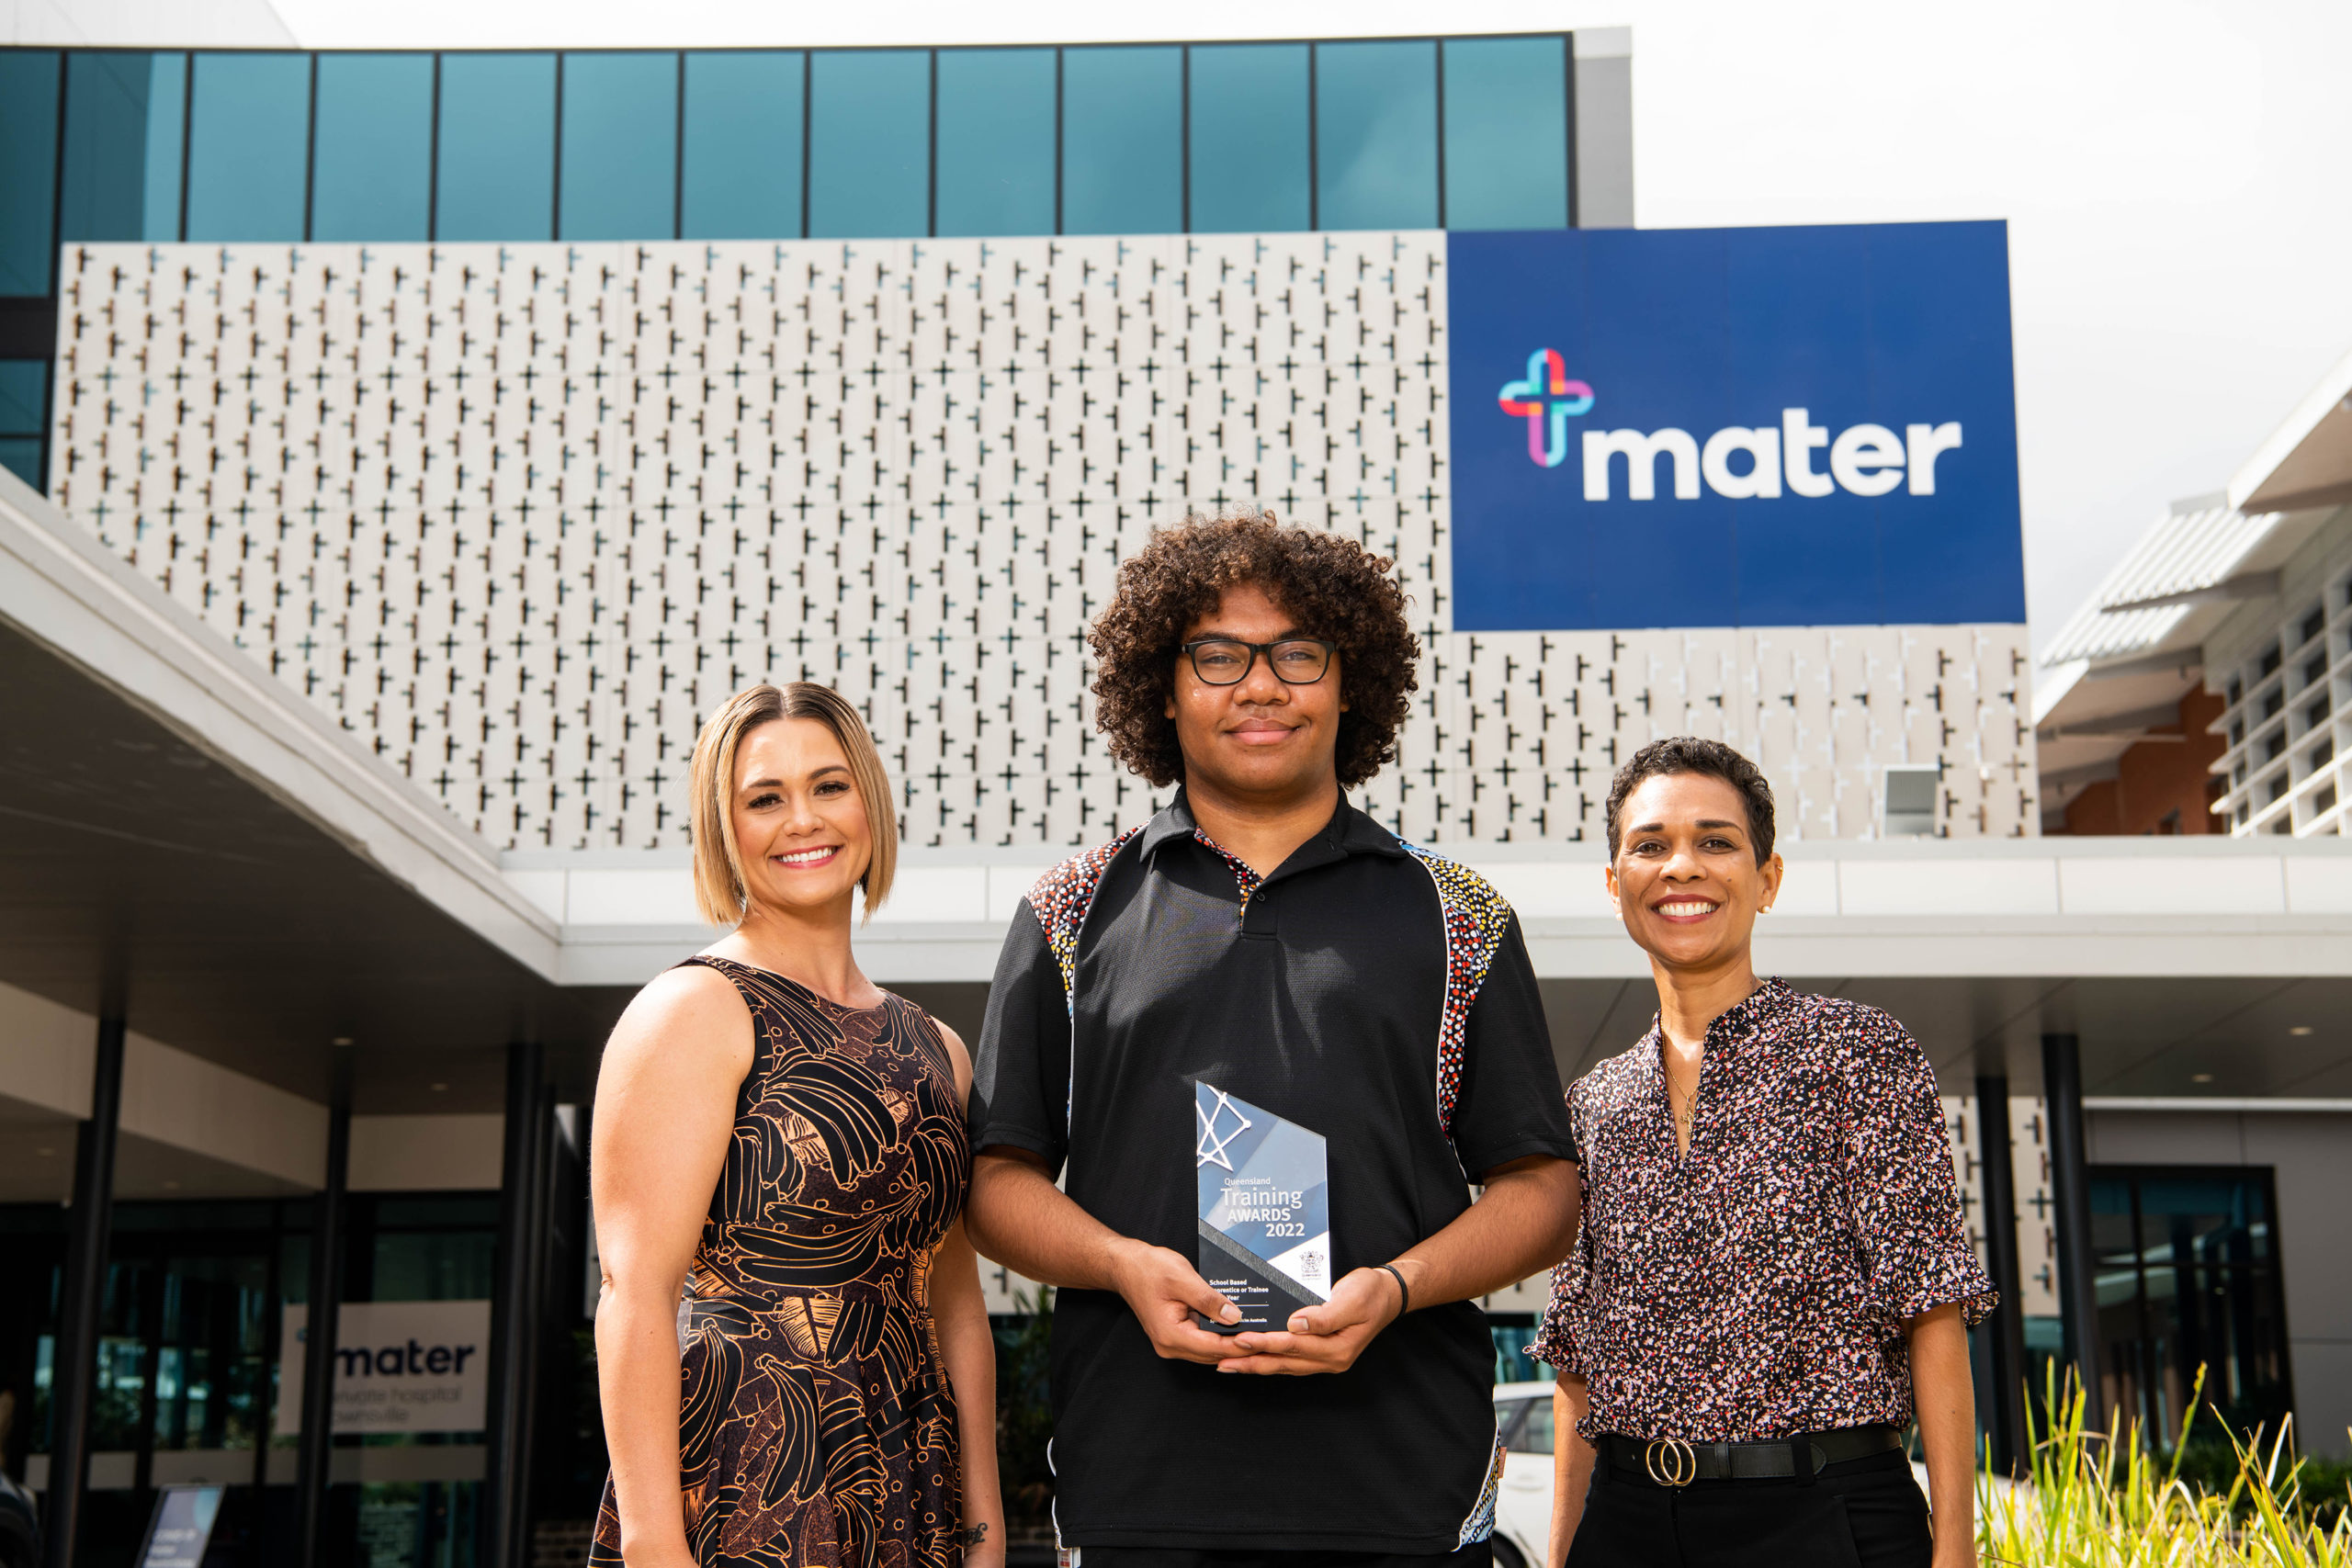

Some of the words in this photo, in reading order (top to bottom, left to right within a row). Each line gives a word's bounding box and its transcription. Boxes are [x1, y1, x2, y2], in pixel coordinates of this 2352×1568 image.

[1582, 408, 1962, 502] mater
[1224, 1177, 1271, 1186] Queensland
[1220, 1186, 1304, 1210] Training
[1227, 1207, 1291, 1222] AWARDS
[1265, 1223, 1306, 1237] 2022
